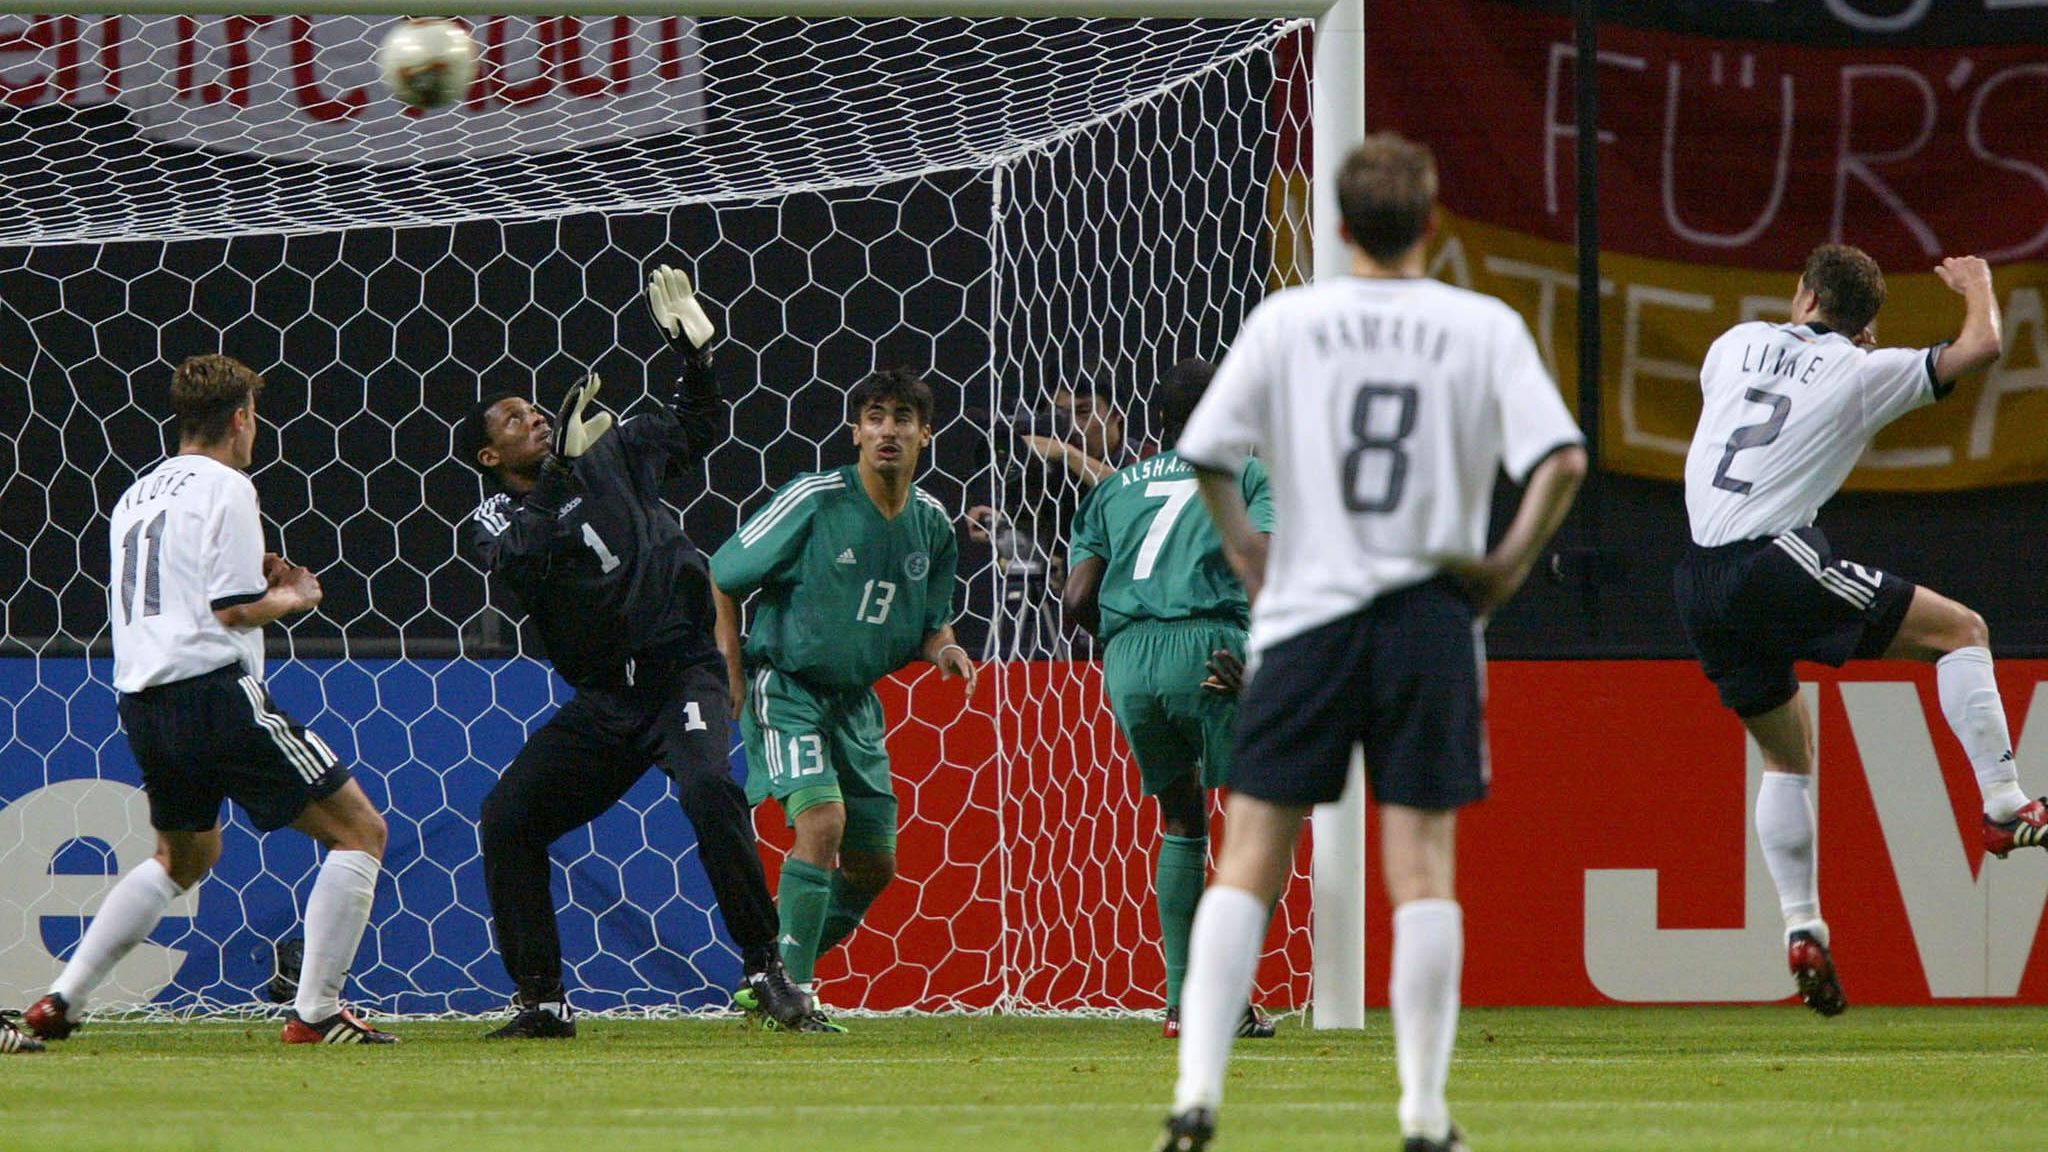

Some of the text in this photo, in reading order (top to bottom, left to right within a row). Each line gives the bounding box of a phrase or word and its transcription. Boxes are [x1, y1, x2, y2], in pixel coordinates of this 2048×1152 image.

[1342, 383, 1418, 514] 8
[1712, 387, 1792, 496] 2
[581, 522, 621, 574] 1
[1133, 478, 1200, 580] 7
[121, 509, 166, 626] 11
[1841, 560, 1883, 588] 2
[856, 579, 896, 625] 13
[682, 702, 708, 732] 1
[788, 734, 824, 779] 13
